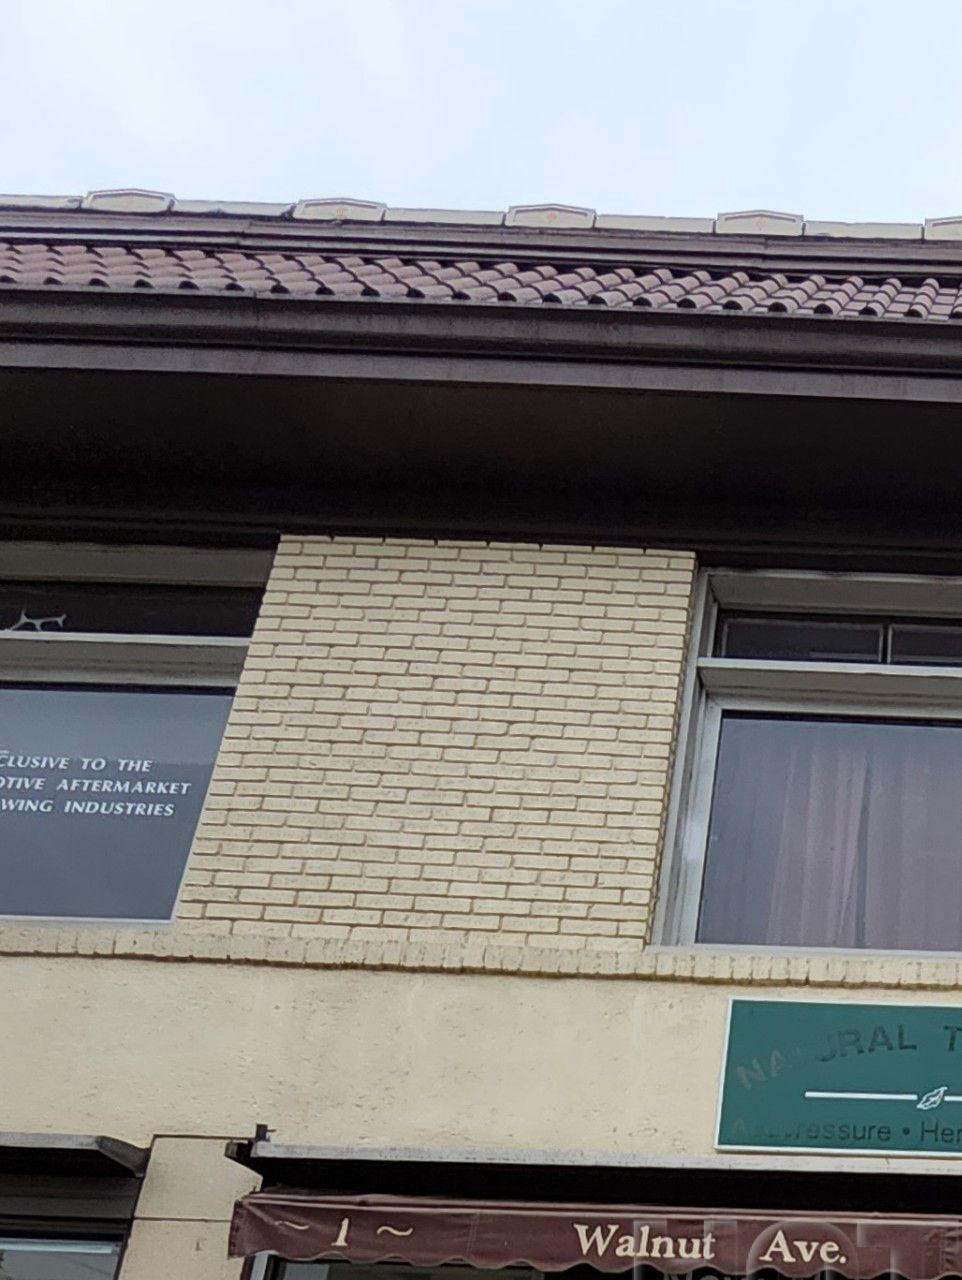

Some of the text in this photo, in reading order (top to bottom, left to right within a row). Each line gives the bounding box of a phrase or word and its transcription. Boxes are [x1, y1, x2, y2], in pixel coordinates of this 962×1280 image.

[80, 758, 106, 771] TO
[118, 759, 153, 773] THE
[57, 779, 192, 795] AFTERMARKET
[64, 801, 175, 816] INDUSTRIES
[573, 1224, 715, 1258] Walnut
[759, 1230, 847, 1264] Ave.
